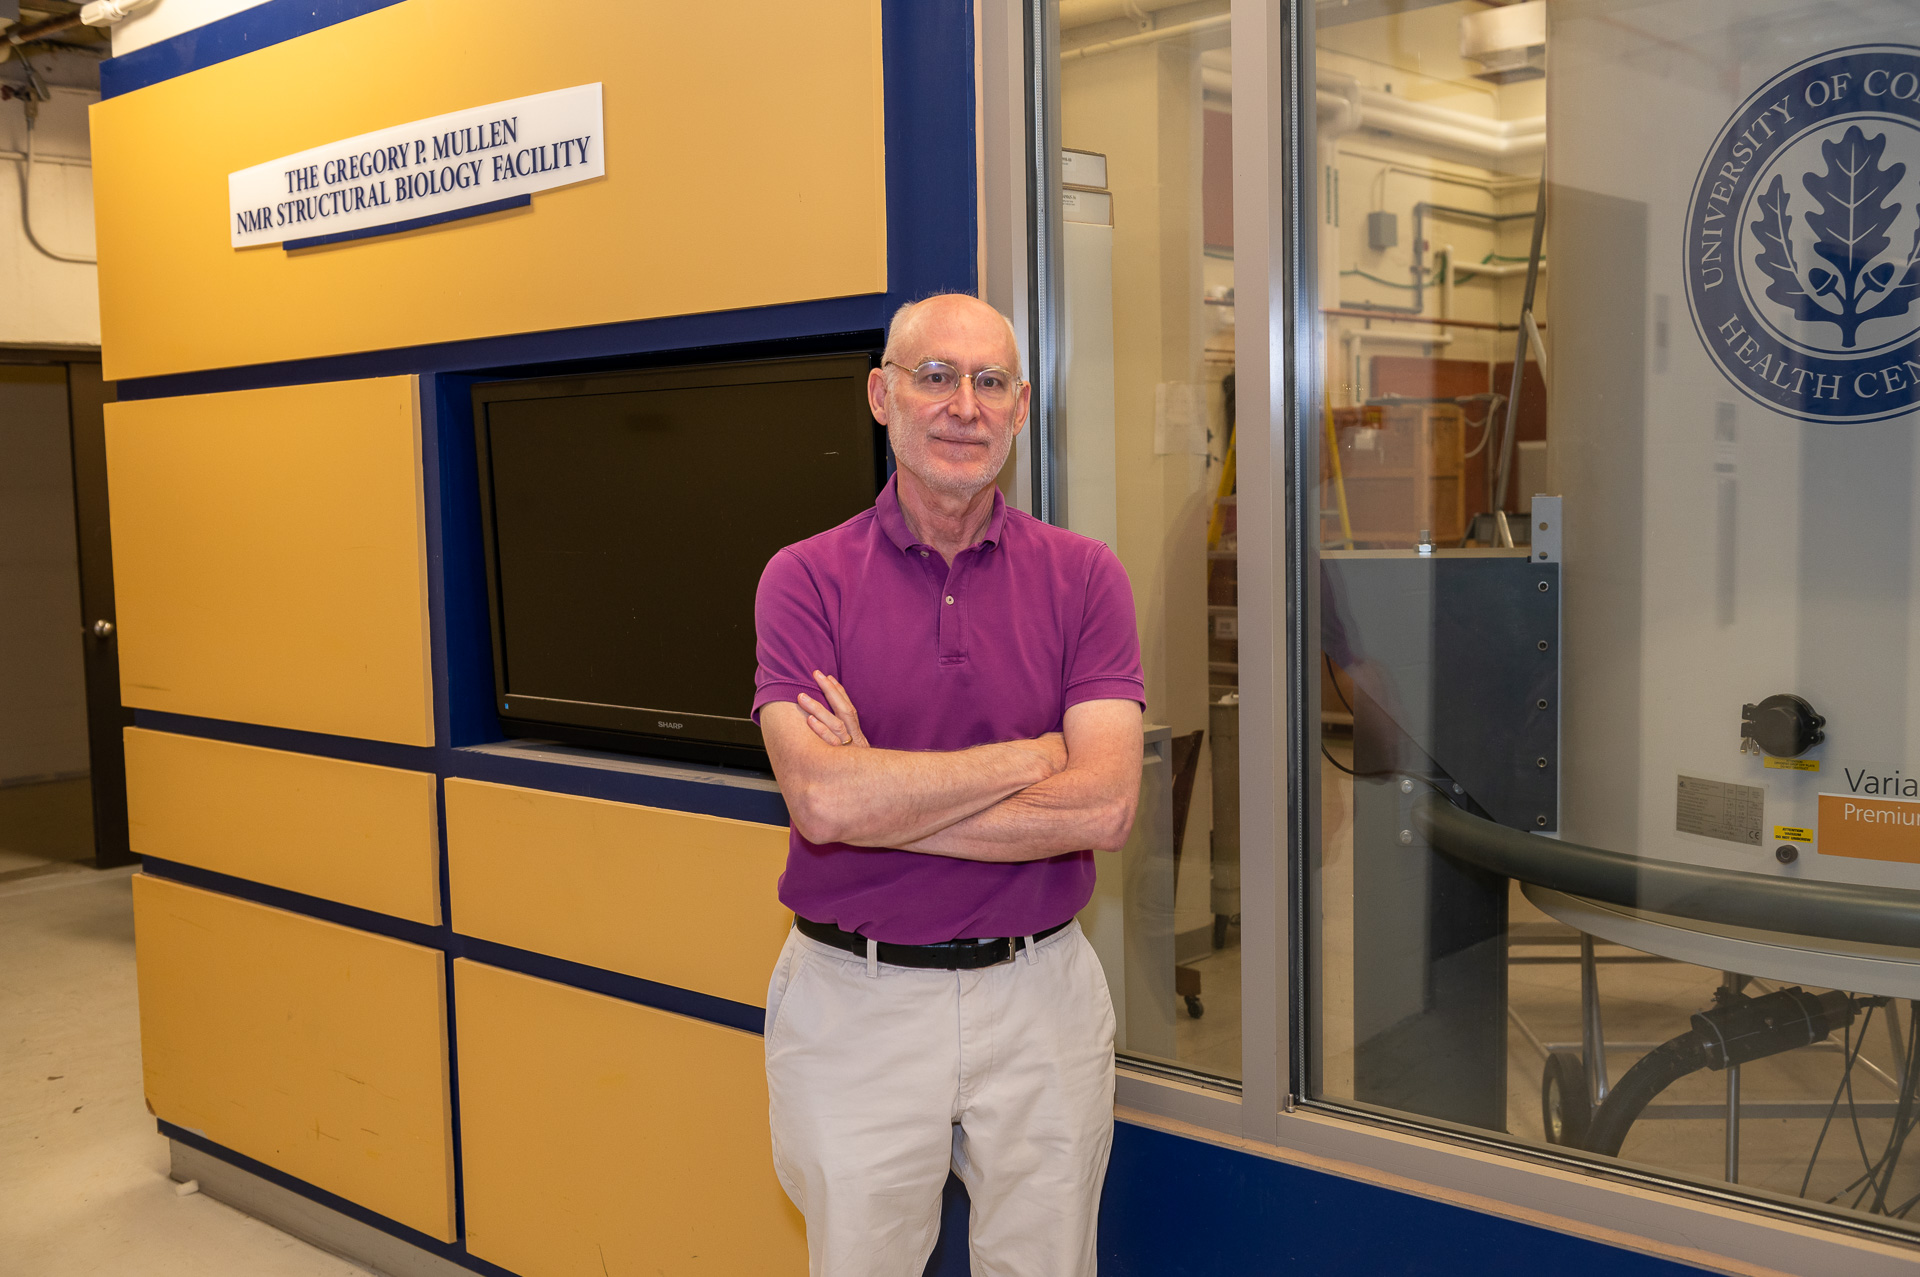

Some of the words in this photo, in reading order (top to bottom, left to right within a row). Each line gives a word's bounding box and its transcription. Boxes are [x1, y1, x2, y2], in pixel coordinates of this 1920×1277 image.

[236, 206, 273, 234] NMR
[277, 181, 391, 226] STRUCTURAL
[395, 159, 483, 202] BIOLOGY
[492, 136, 591, 182] FACILITY
[285, 165, 320, 194] THE
[324, 142, 410, 185] GREGORY
[414, 139, 427, 165] P.
[432, 116, 518, 161] MULLEN
[1702, 94, 1795, 292] UNIVERSITY
[1804, 72, 1853, 108] OF
[1863, 69, 1920, 104] CO
[1717, 312, 1843, 400] HEALTH
[657, 720, 684, 730] SHARP
[1844, 767, 1918, 797] Varia
[1844, 802, 1920, 827] Premiu
